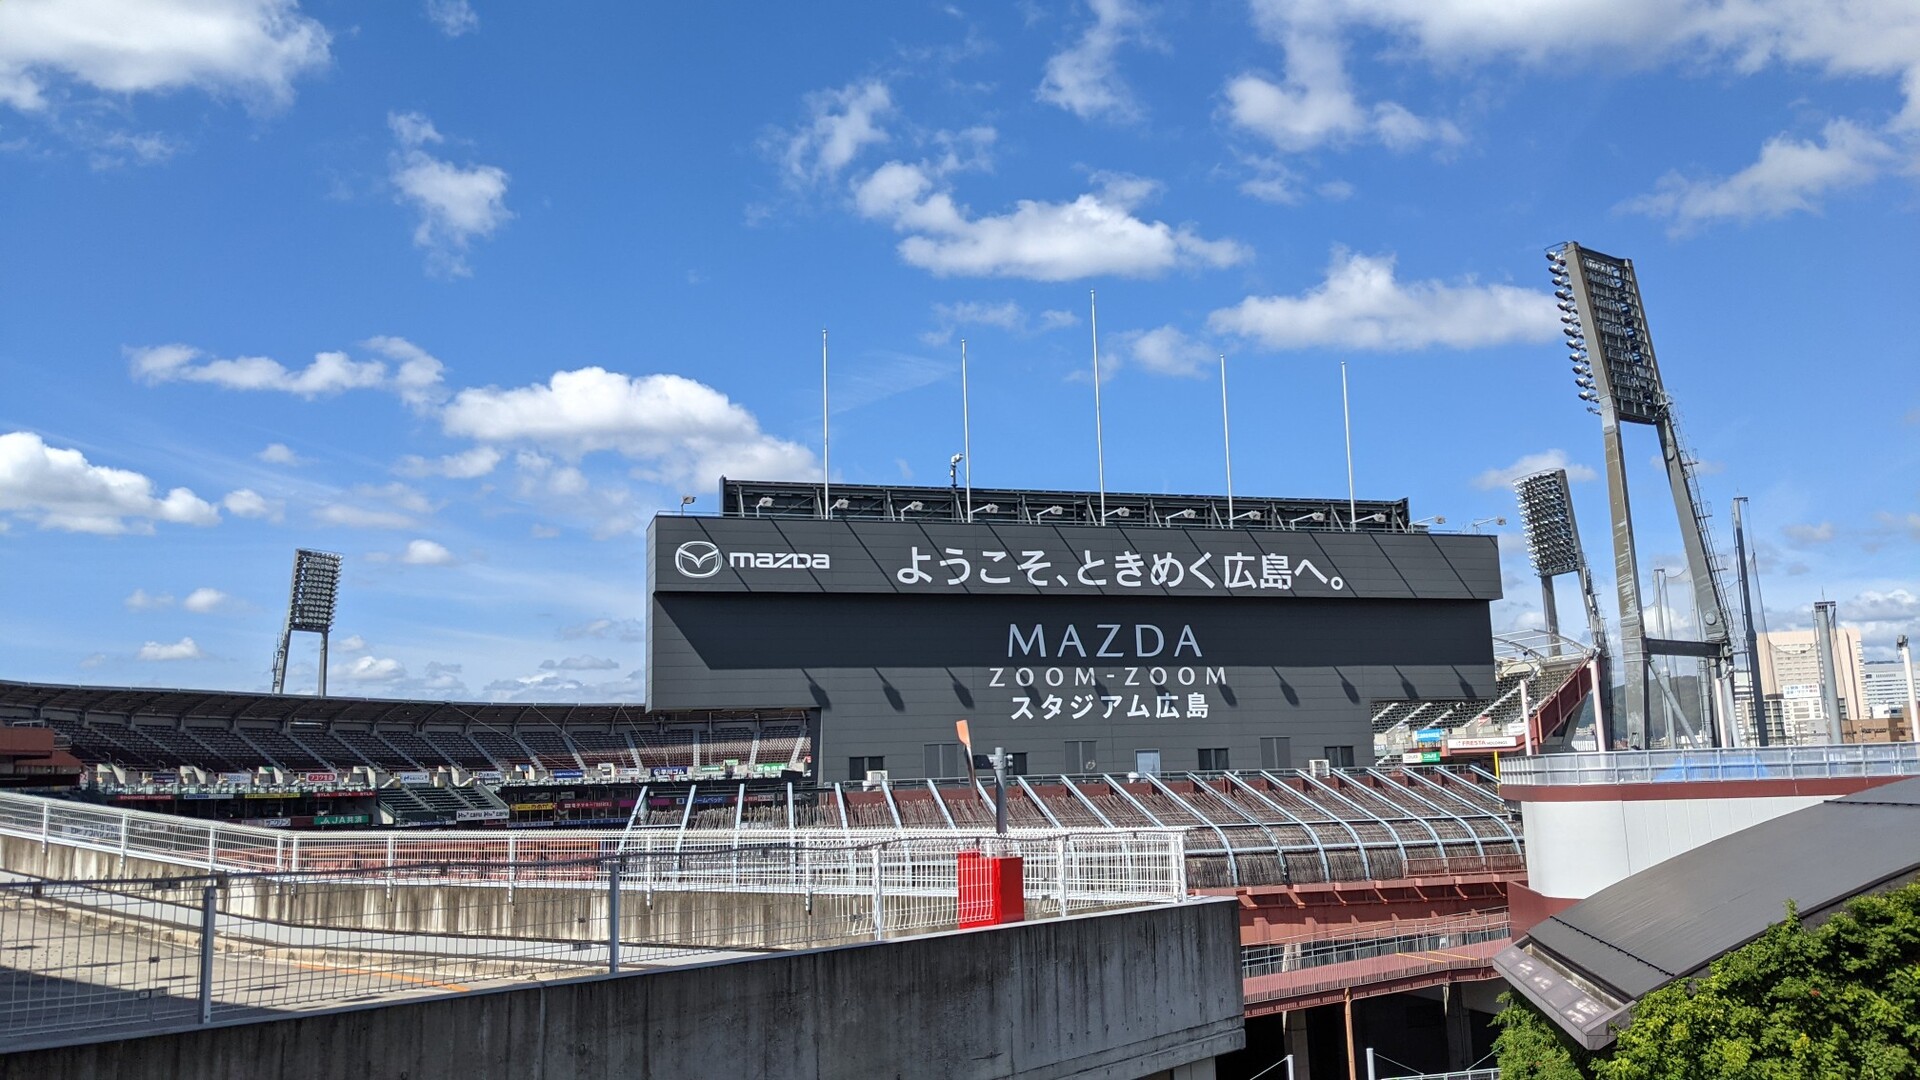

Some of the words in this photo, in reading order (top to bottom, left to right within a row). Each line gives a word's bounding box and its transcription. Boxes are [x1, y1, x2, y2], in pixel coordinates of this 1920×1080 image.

[897, 546, 1344, 591] ようこそ、ときめく広島へ。
[1007, 623, 1203, 658] MAZDA
[988, 666, 1227, 687] ZOOM-ZOOM
[1010, 692, 1209, 720] スタジアム広島
